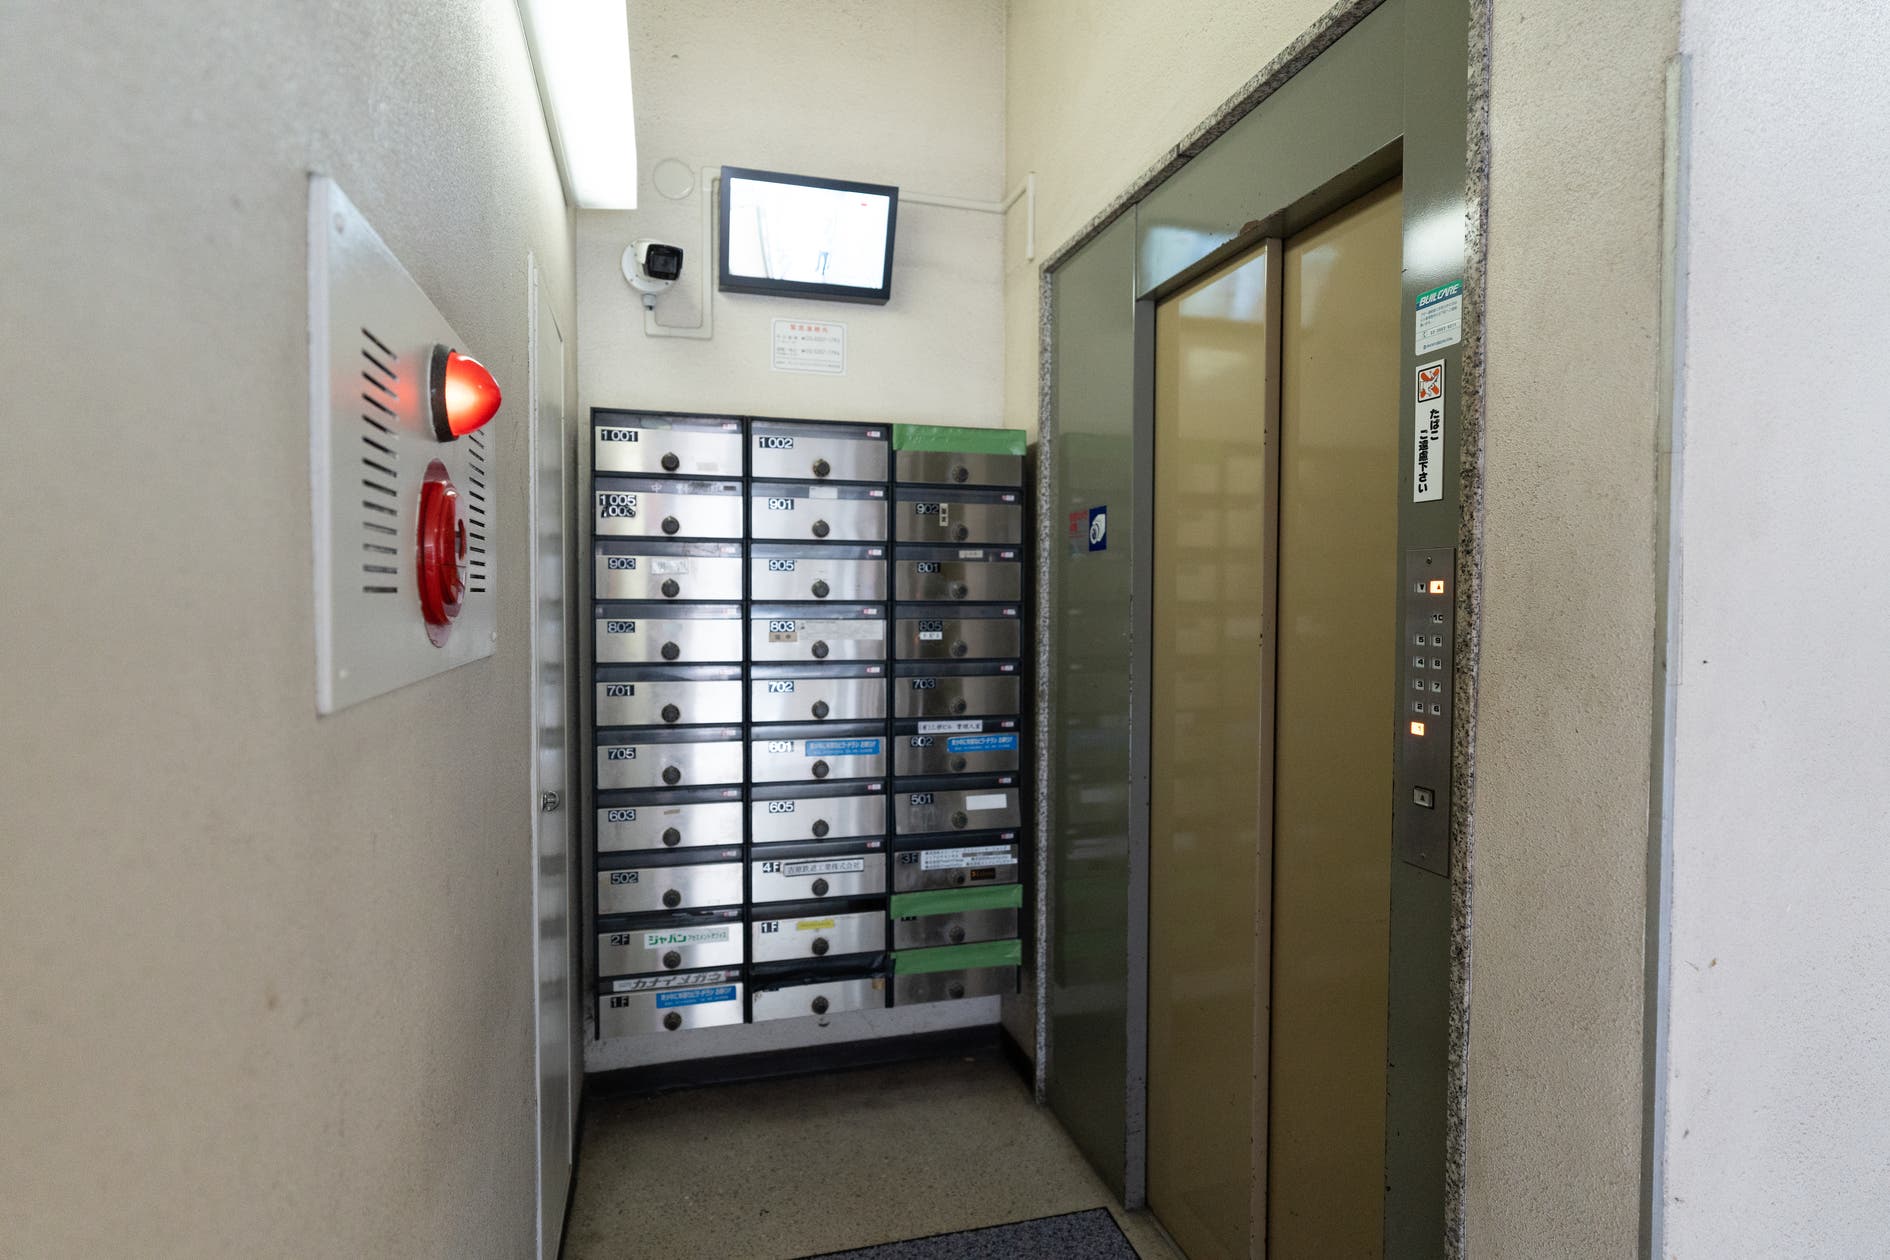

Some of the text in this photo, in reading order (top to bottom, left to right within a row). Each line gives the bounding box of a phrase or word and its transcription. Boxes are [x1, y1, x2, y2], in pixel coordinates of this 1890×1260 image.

[1429, 408, 1440, 441] たばこ
[601, 429, 637, 442] 1001
[759, 437, 793, 449] 1002
[1418, 430, 1429, 494] ご遠慮下さい
[600, 494, 636, 507] 1005
[769, 498, 794, 510] 901
[916, 503, 939, 514] 902
[609, 558, 636, 570] 903
[769, 560, 794, 571] 905
[608, 621, 635, 633] 802
[769, 620, 794, 632] 803
[607, 685, 634, 697] 701
[769, 681, 794, 692] 702
[769, 741, 794, 752] 601
[911, 736, 934, 747] 602
[609, 748, 636, 760] 705
[910, 794, 934, 805] 501
[769, 801, 794, 812] 605
[609, 809, 636, 821] 603
[763, 861, 781, 873] 4F
[611, 872, 638, 884] 502
[761, 921, 779, 933] 1F
[611, 934, 630, 946] 2F
